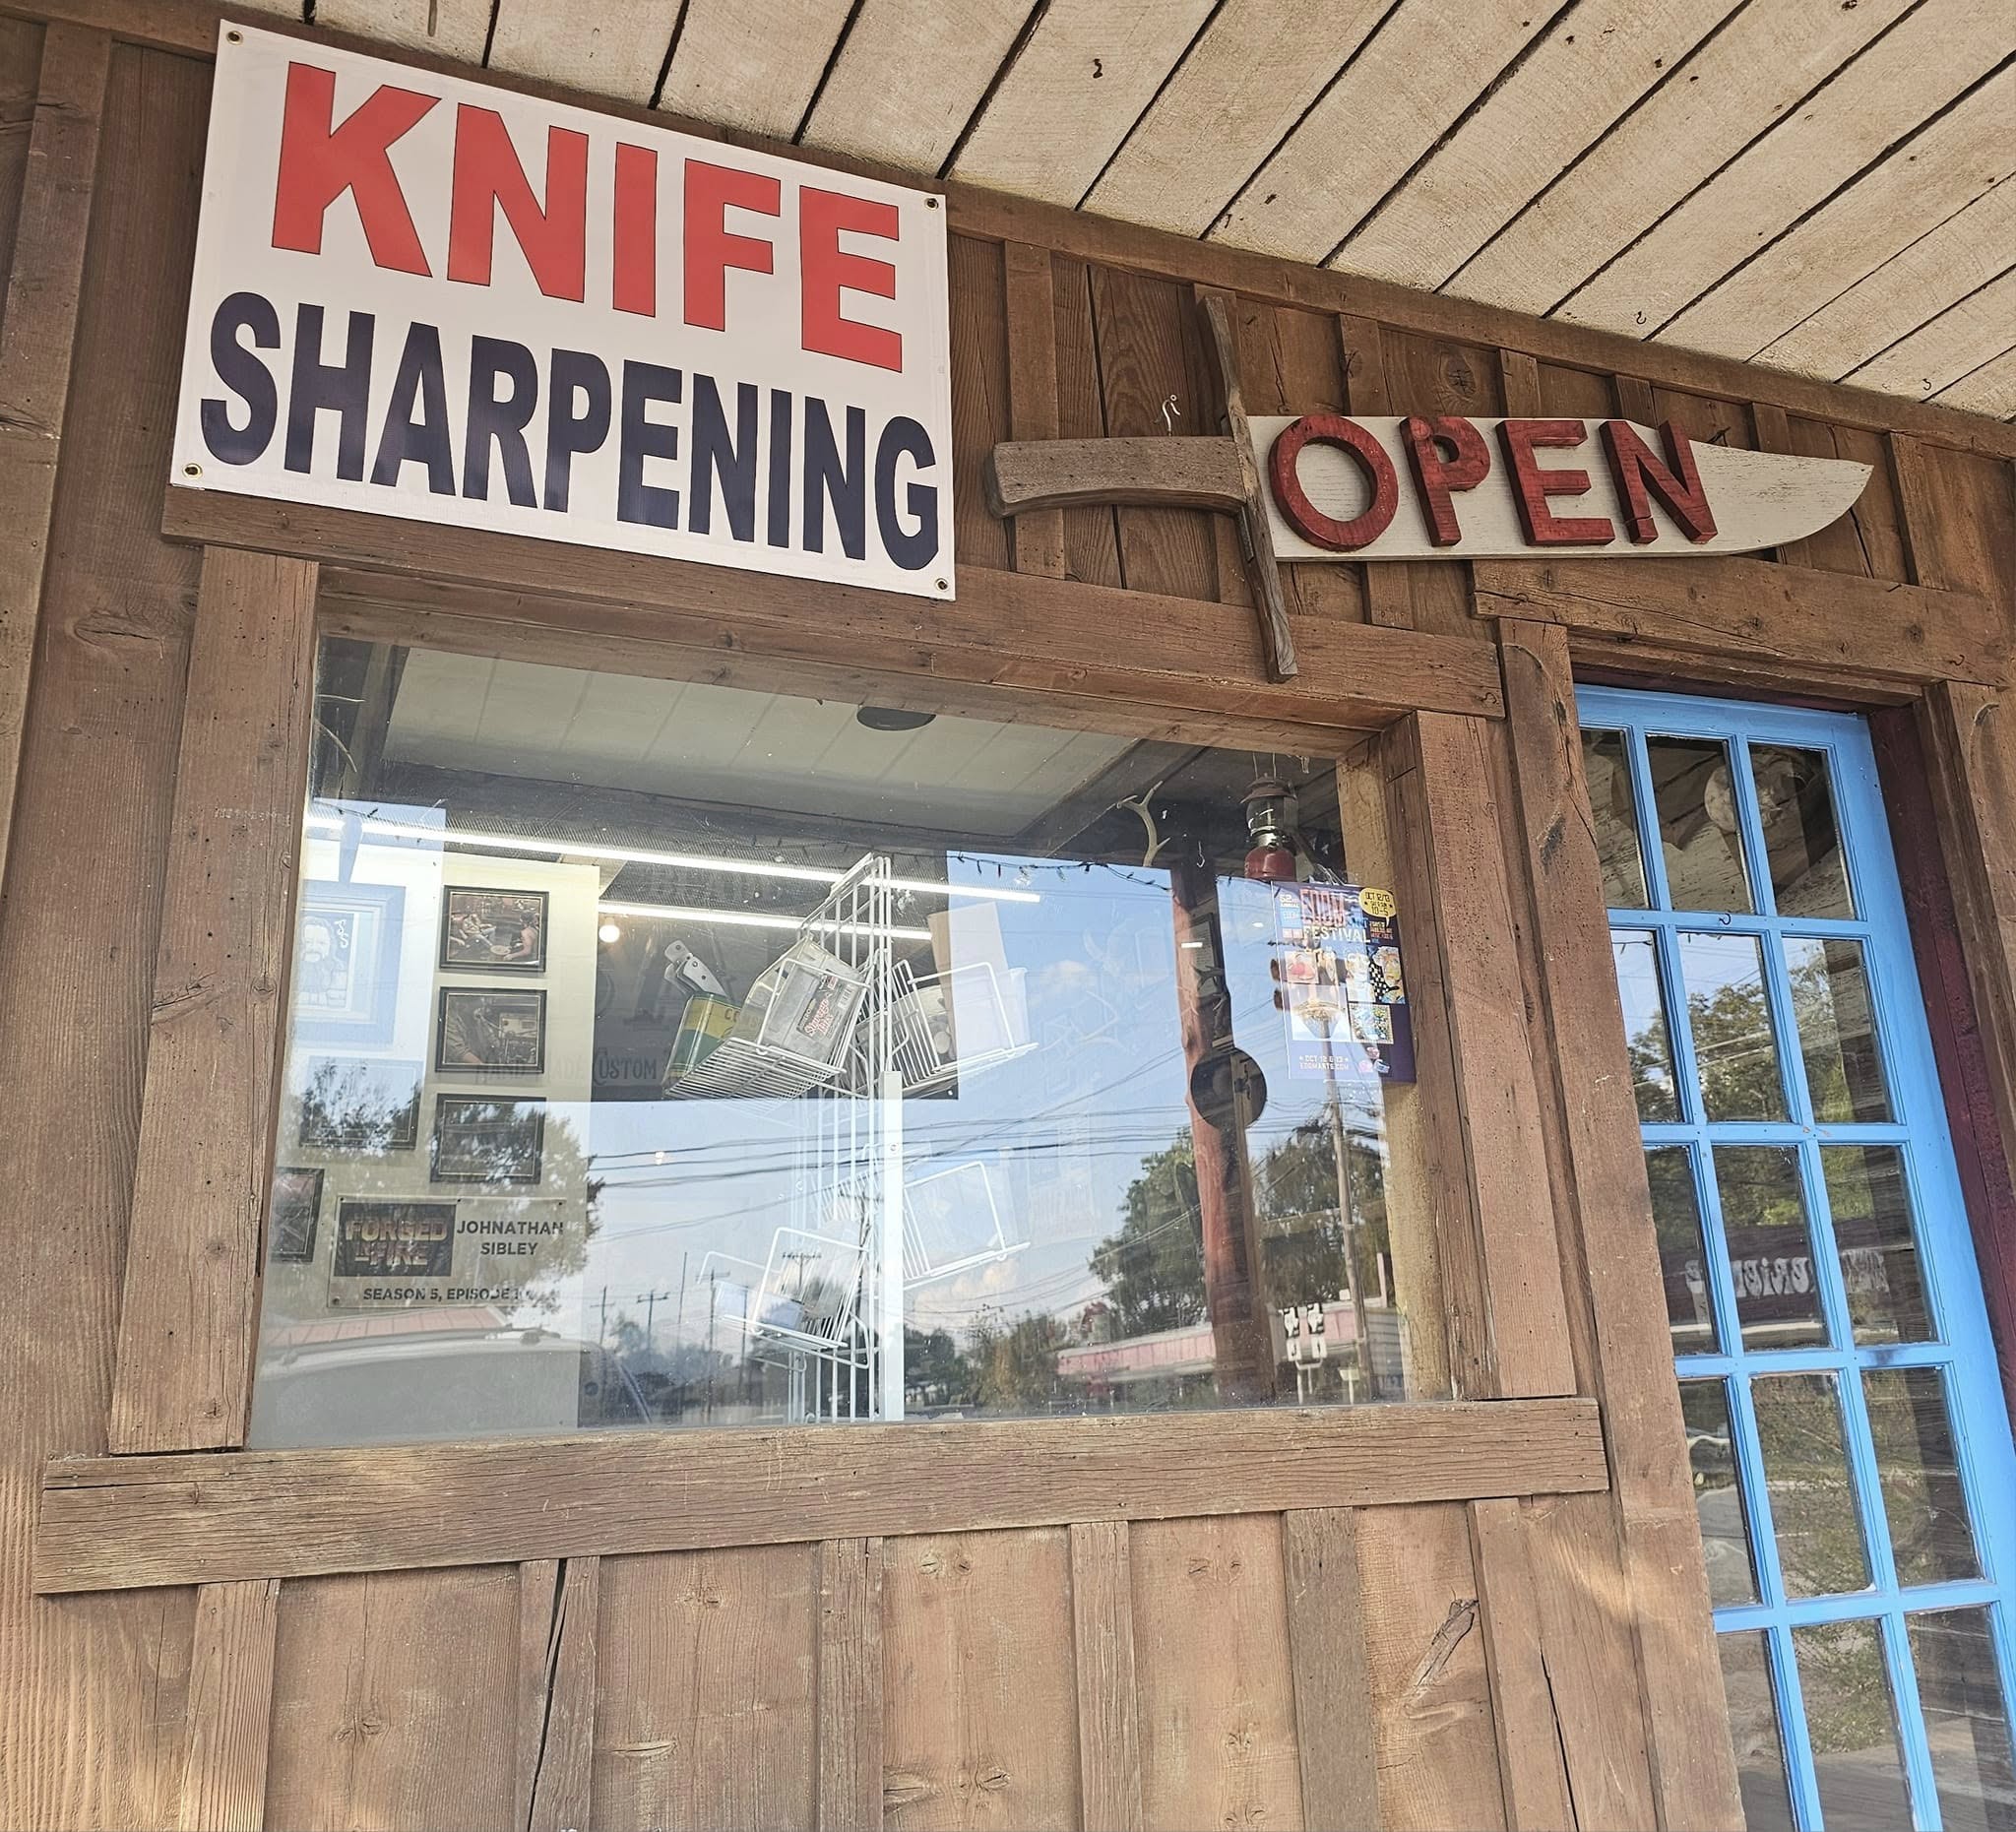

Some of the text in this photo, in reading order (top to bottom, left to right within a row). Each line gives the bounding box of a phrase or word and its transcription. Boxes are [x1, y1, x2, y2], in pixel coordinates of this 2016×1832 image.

[272, 61, 903, 373] KNIFE
[201, 291, 939, 570] SHARPENING
[1269, 413, 1719, 553] OPEN
[1302, 925, 1371, 944] FESTIVAL
[346, 1219, 448, 1241] FORGED
[457, 1220, 564, 1235] JOHNATHAN
[369, 1241, 429, 1266] FIRE
[480, 1241, 538, 1256] SIBLEY
[363, 1287, 426, 1301] SEASON
[429, 1288, 442, 1302] 5,
